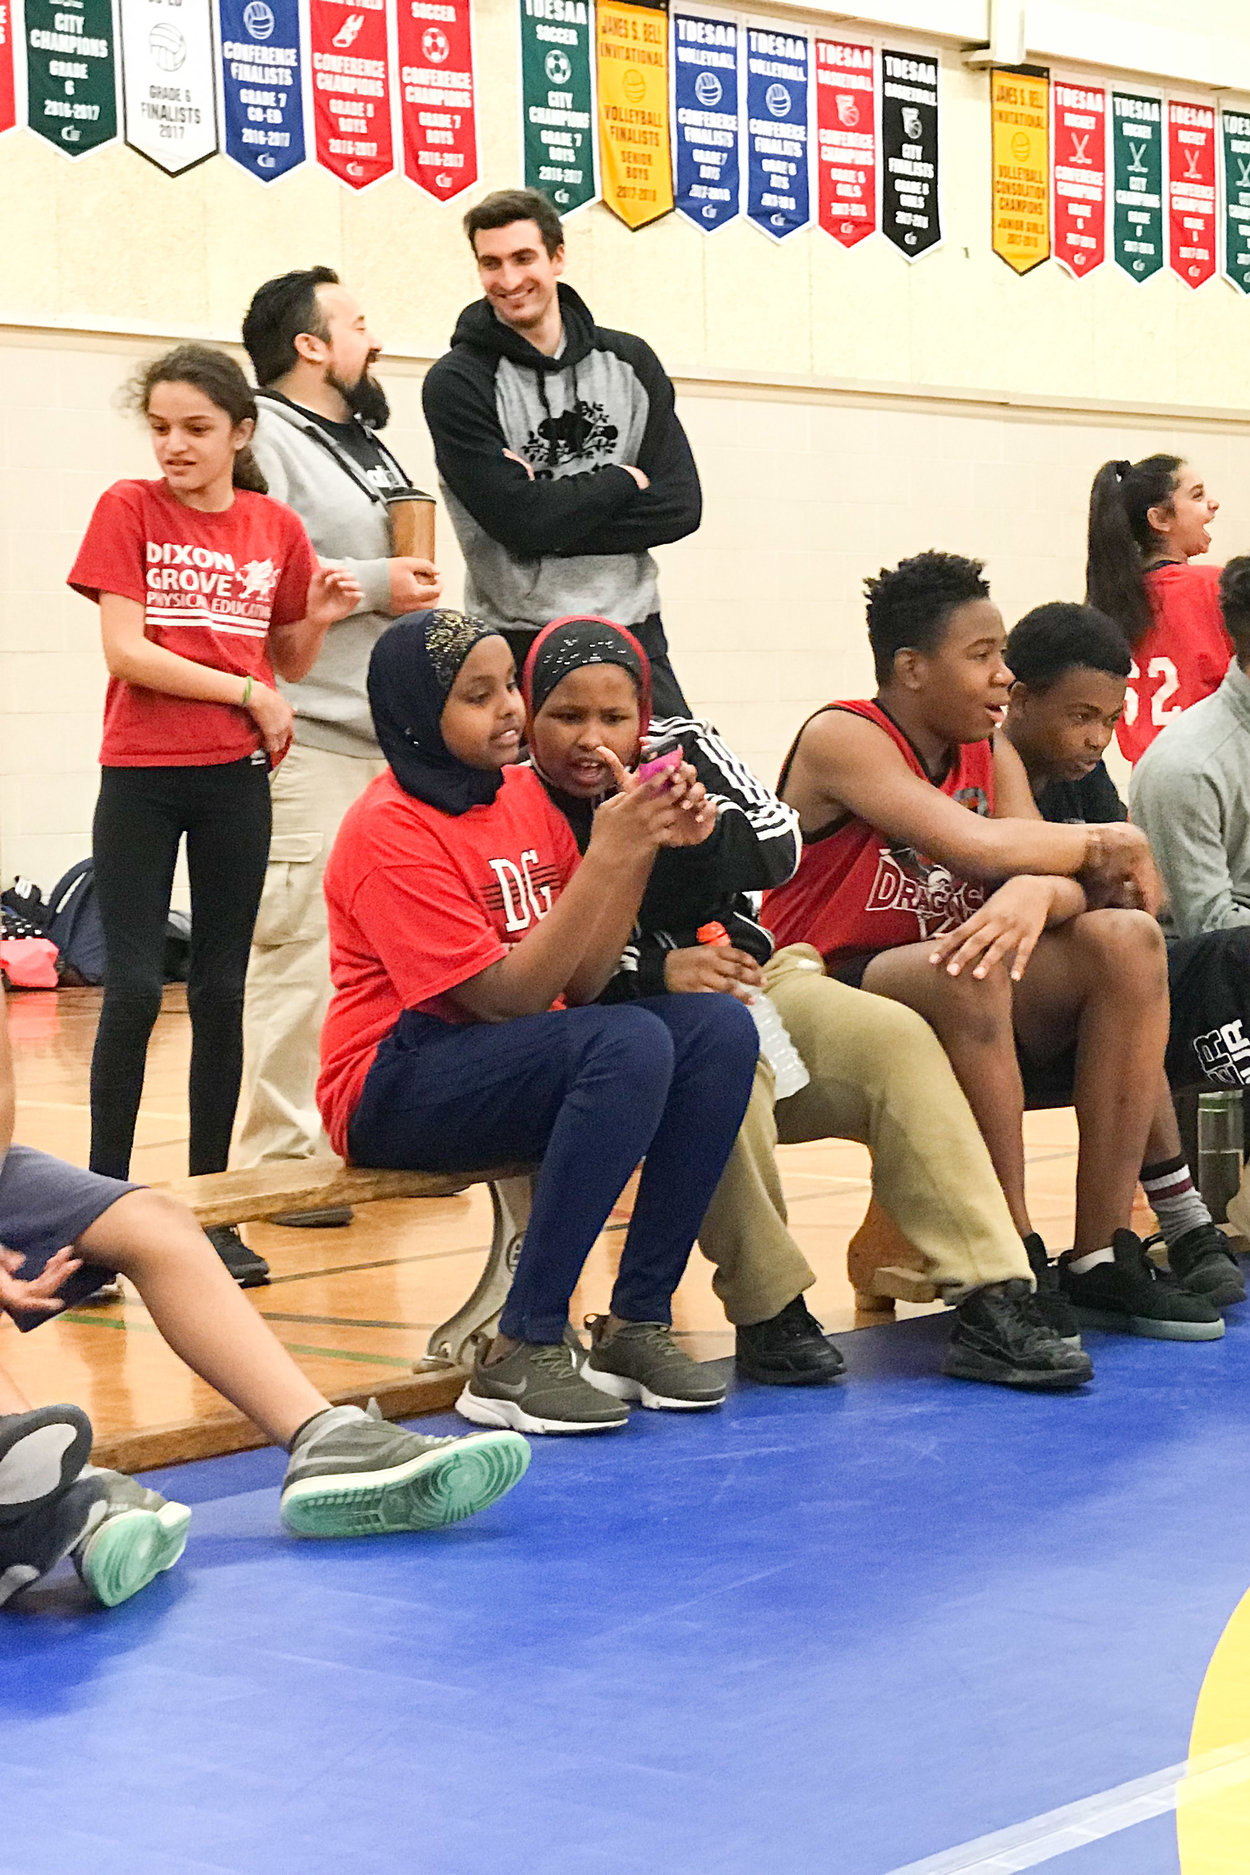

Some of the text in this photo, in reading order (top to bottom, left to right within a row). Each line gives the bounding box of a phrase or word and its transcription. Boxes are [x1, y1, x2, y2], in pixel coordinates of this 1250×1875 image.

[54, 13, 84, 34] CITY
[602, 15, 628, 38] JAMES
[643, 23, 662, 45] BELL
[31, 29, 108, 58] CHAMPIONS
[224, 41, 298, 66] CONFERENCE
[600, 42, 664, 68] INVITATIONAL
[231, 62, 293, 86] FINALISTS
[149, 84, 181, 102] GRADE
[141, 102, 201, 124] FINALISTS
[603, 104, 663, 128] VOLLEYBALL
[159, 124, 185, 139] 2017
[610, 125, 660, 147] FINALISTS
[621, 150, 653, 166] SENIOR
[626, 166, 649, 180] BOYS
[146, 541, 235, 572] DIXON
[145, 566, 234, 597] GROVE
